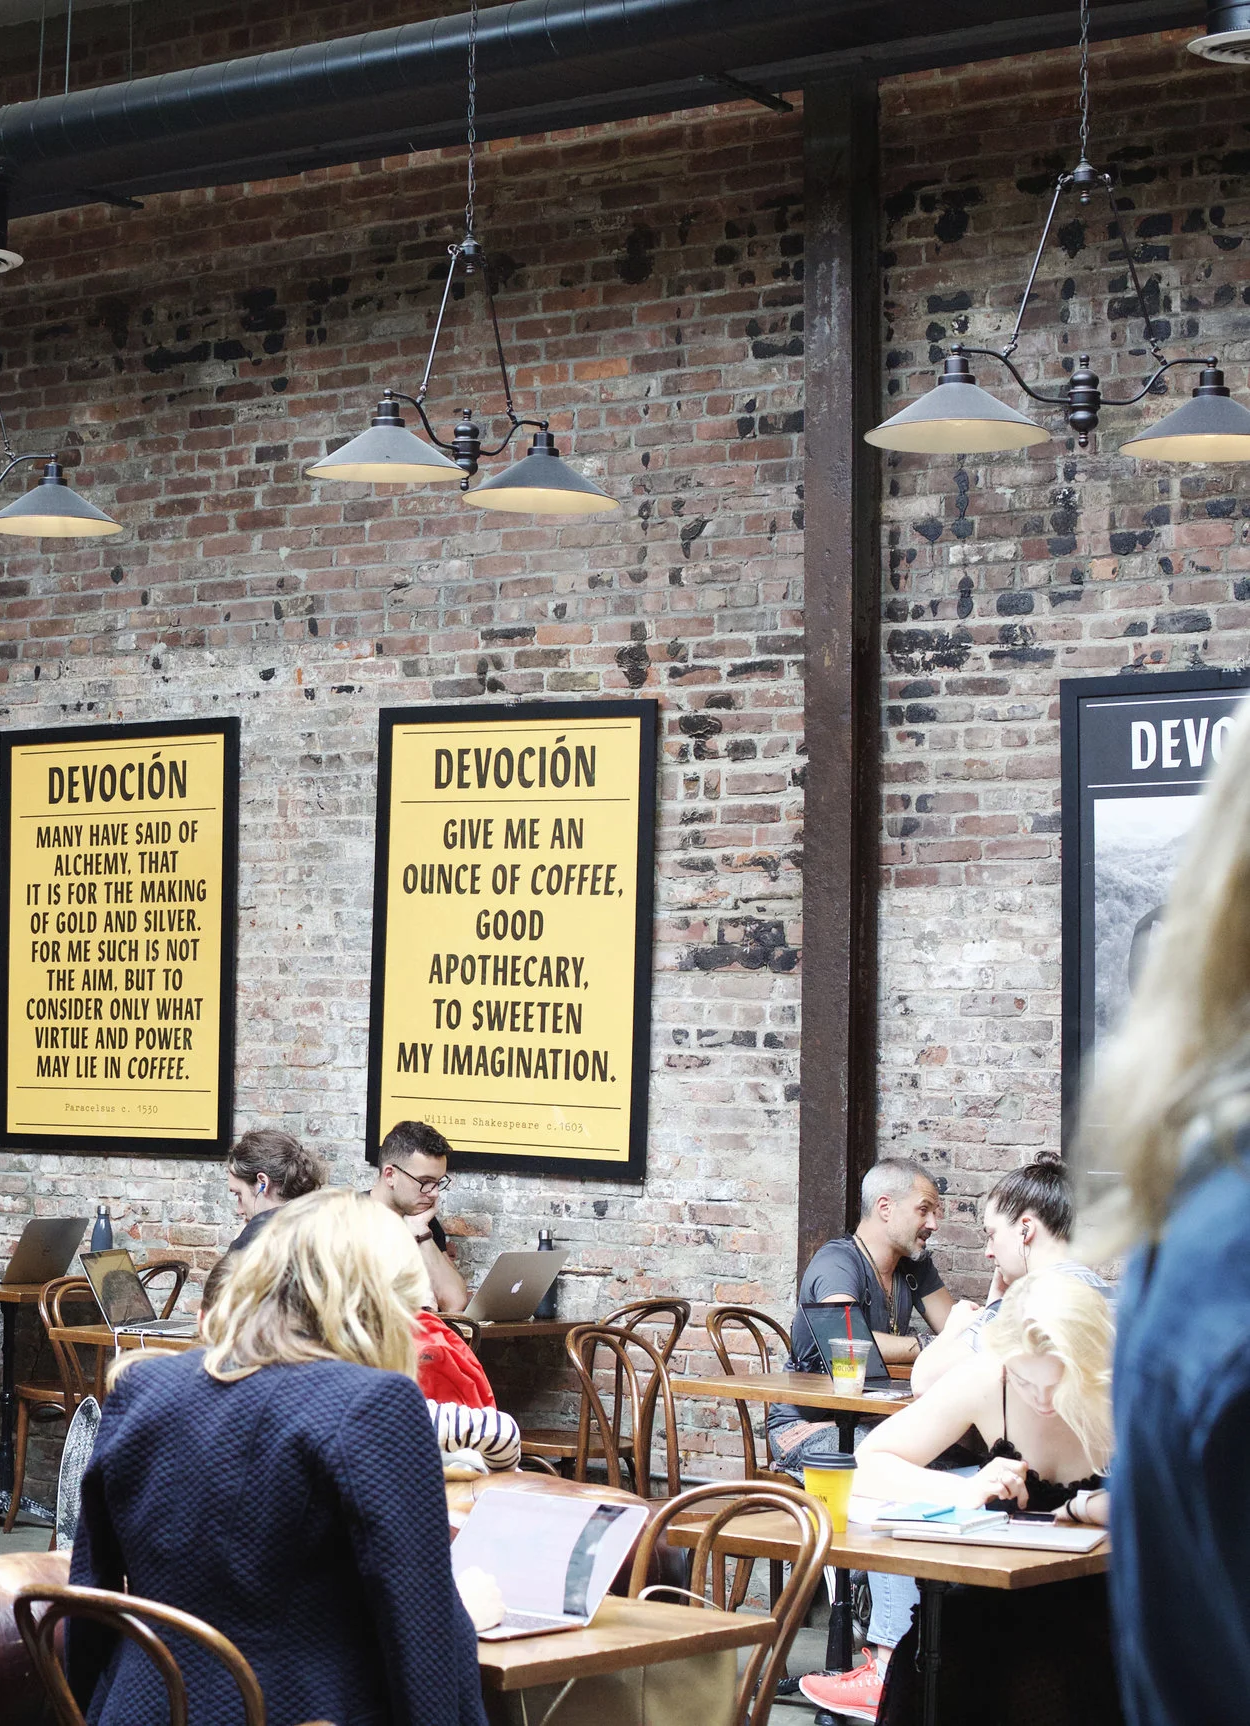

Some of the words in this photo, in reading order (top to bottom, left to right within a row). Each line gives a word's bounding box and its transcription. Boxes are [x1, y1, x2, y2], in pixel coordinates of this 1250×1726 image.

[1131, 716, 1237, 769] DEVO
[435, 735, 595, 789] DEVOCIÓN
[48, 751, 187, 804] DEVOCIÓN
[37, 825, 82, 848] MANY
[90, 823, 128, 846] HAVE
[136, 822, 171, 845] SAID
[179, 821, 198, 843] OF
[444, 819, 493, 849] GIVE
[504, 819, 540, 849] ME
[550, 818, 583, 849] AN
[54, 853, 131, 876] ALCHEMY,
[138, 851, 179, 873] THAT
[27, 884, 41, 905] IT
[48, 884, 60, 905] IS
[68, 882, 97, 904] FOR
[104, 881, 133, 903] THE
[141, 879, 206, 903] MAKING
[403, 864, 481, 894] OUNCE
[492, 864, 520, 895] OF
[531, 864, 622, 897] COFFEE,
[31, 912, 49, 934] OF
[56, 911, 97, 933] GOLD
[104, 911, 136, 932] AND
[144, 909, 201, 932] SILVER.
[476, 909, 543, 941] GOOD
[32, 941, 60, 962] FOR
[68, 940, 90, 962] ME
[98, 940, 138, 962] SUCH
[146, 939, 159, 961] IS
[167, 939, 200, 961] NOT
[47, 969, 75, 991] THE
[82, 969, 117, 992] AIM,
[125, 969, 155, 991] BUT
[163, 969, 182, 991] TO
[429, 954, 588, 989] APOTHECARY,
[27, 998, 102, 1020] CONSIDER
[110, 998, 149, 1020] ONLY
[157, 998, 203, 1020] WHAT
[433, 999, 461, 1030] TO
[473, 1000, 582, 1034] SWEETEN
[35, 1027, 88, 1049] VIRTUE
[95, 1027, 128, 1049] AND
[136, 1028, 192, 1050] POWER
[37, 1056, 69, 1077] MAY
[77, 1056, 97, 1078] LIE
[105, 1057, 120, 1078] IN
[128, 1057, 189, 1079] COFFEE.
[397, 1043, 433, 1073] MY
[443, 1044, 616, 1082] IMAGINATION.
[64, 1103, 116, 1113] Paracelsus
[136, 1104, 159, 1115] 1530
[424, 1114, 466, 1125] William
[472, 1117, 540, 1131] Shakespeare
